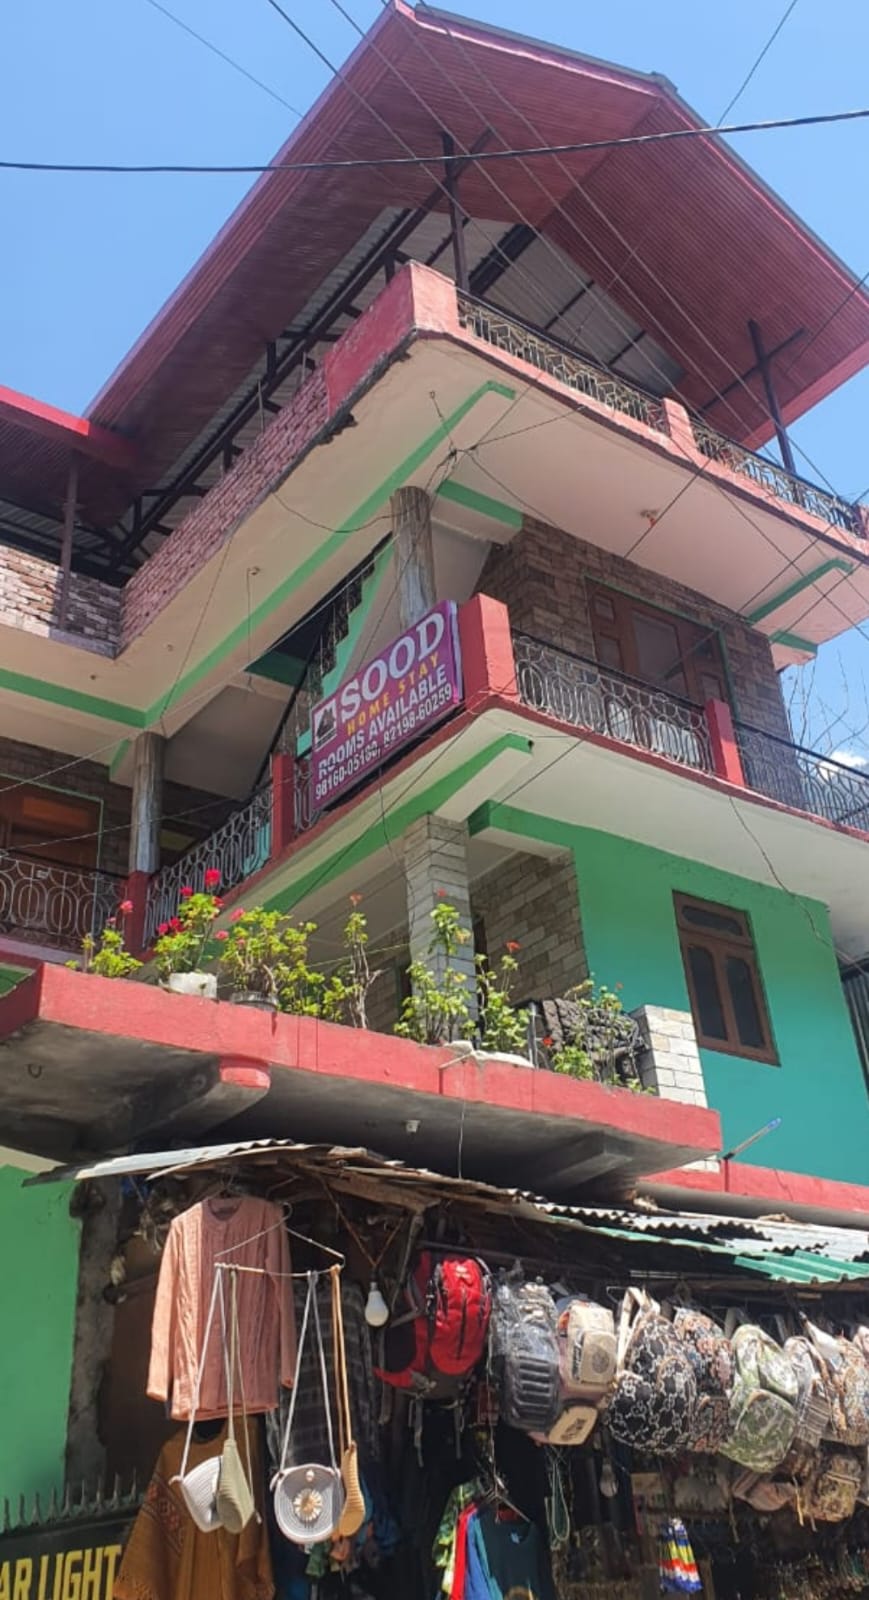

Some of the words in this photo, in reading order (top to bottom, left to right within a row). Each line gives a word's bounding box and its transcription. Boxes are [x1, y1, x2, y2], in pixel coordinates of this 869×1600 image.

[318, 729, 365, 780] ROOMS
[368, 663, 447, 741] AVAILABLE
[341, 612, 445, 723] SOOD
[347, 691, 390, 737] HOME
[398, 651, 439, 695] STAY
